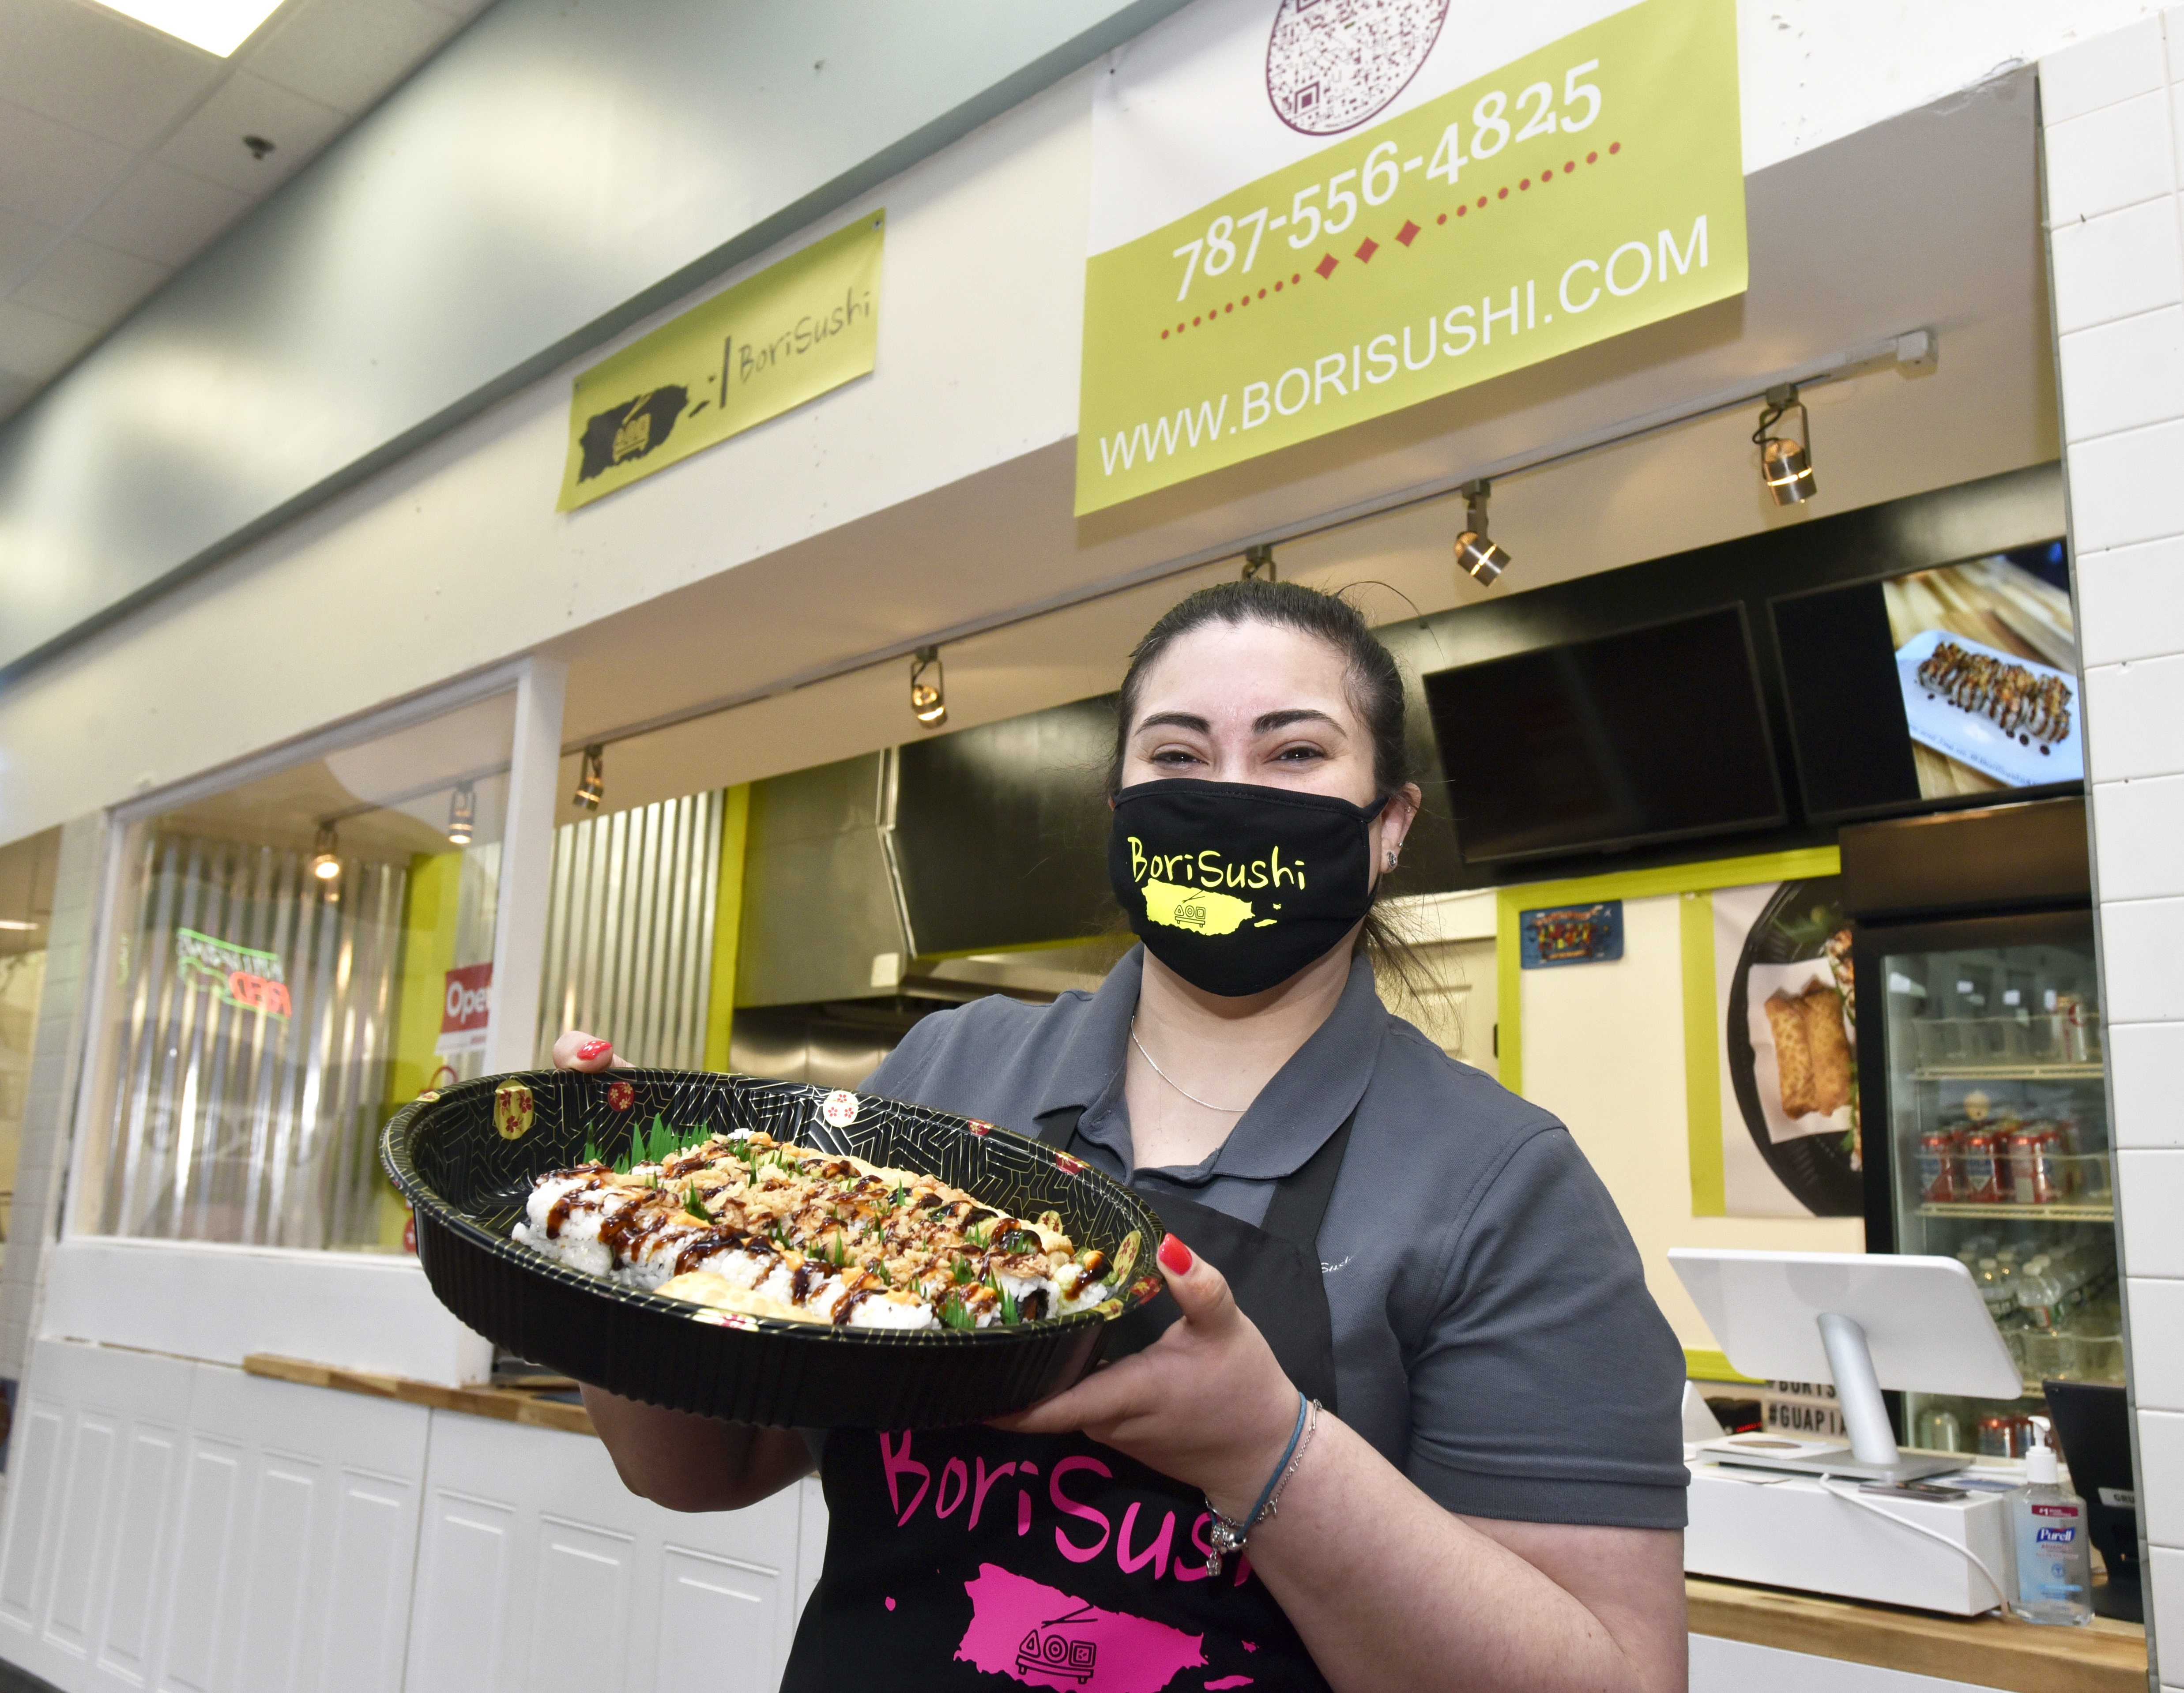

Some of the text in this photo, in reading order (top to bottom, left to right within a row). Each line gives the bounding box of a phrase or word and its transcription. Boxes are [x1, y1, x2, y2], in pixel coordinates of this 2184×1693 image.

[1173, 58, 1602, 302] 787-556-4825
[739, 286, 870, 382] BoriSushi
[1100, 214, 1709, 476] WWW.BORISUSHI.COM
[1127, 836, 1305, 891] BoriSushi
[447, 980, 490, 1024] Ope
[879, 1429, 1253, 1588] BoriSus
[2040, 1527, 2072, 1542] Purell
